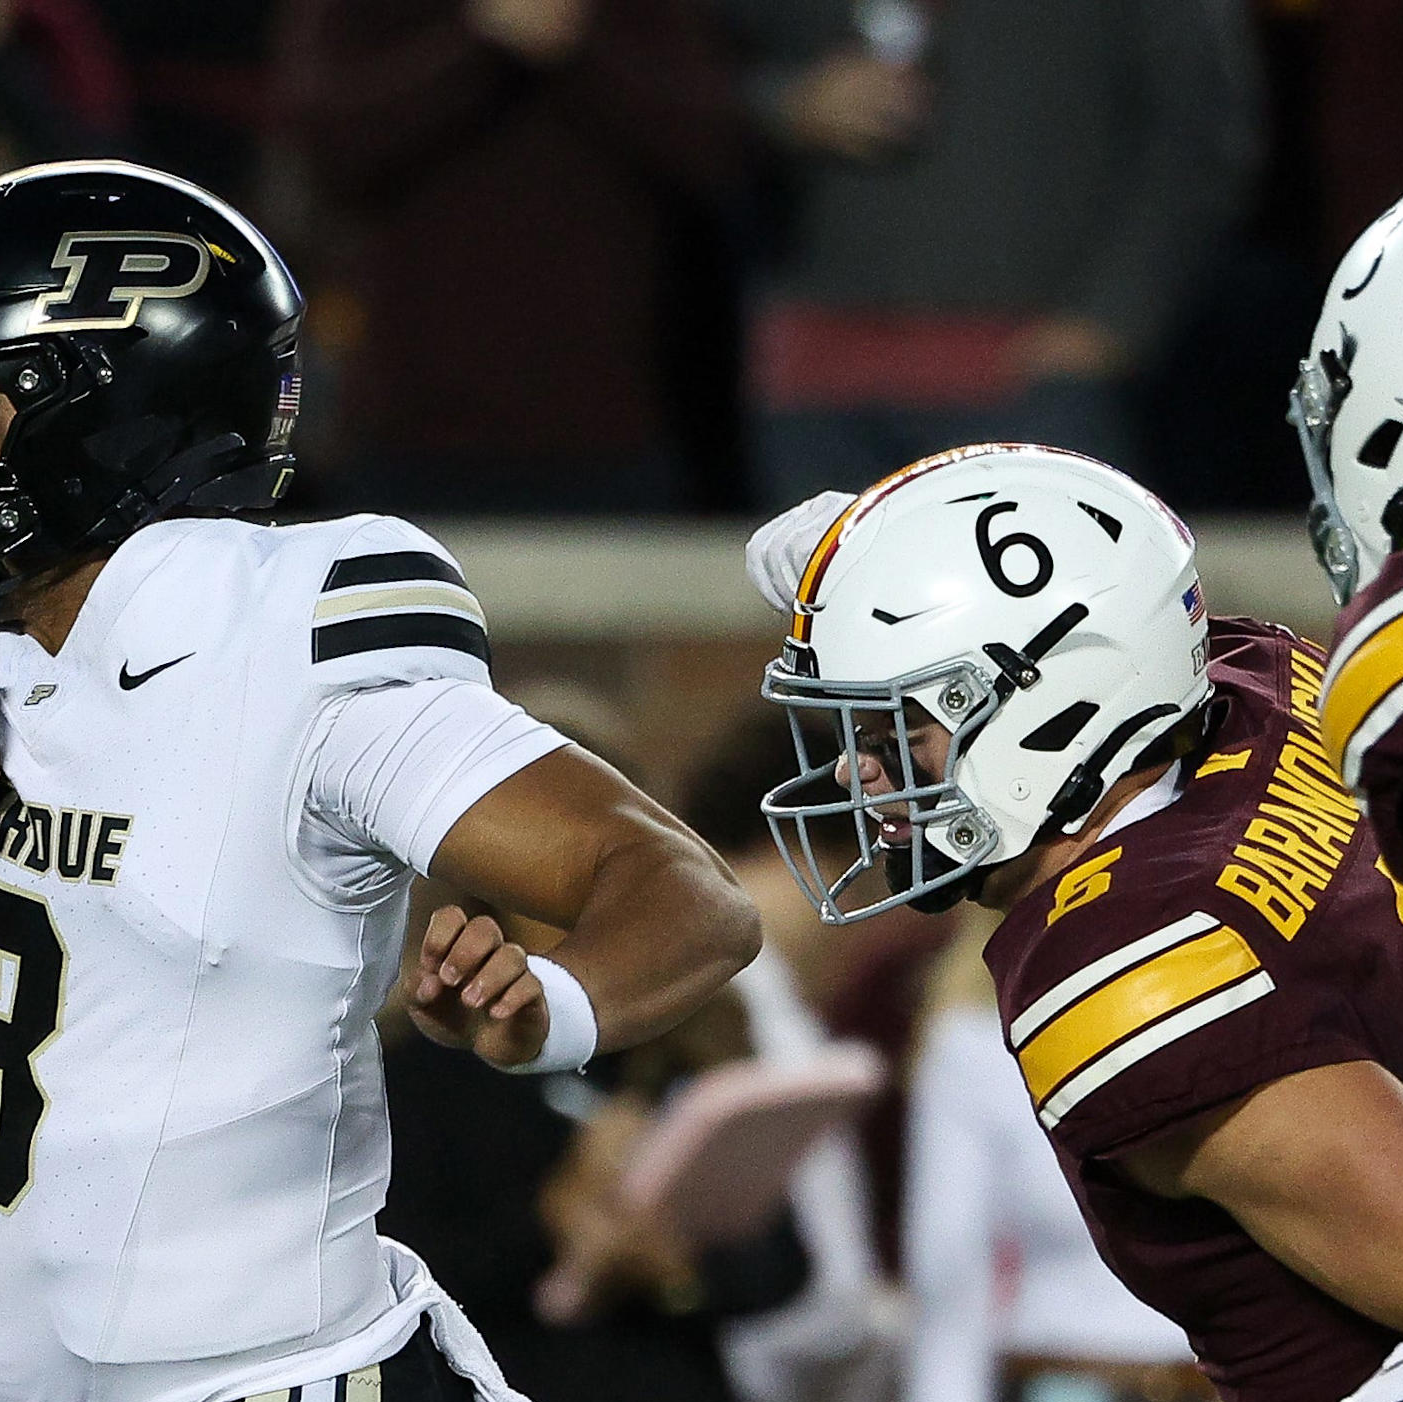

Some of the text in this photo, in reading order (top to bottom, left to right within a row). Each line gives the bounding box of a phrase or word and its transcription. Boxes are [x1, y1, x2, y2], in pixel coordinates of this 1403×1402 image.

[25, 230, 212, 335] P
[975, 501, 1054, 598] 6
[0, 801, 134, 888] RDUE
